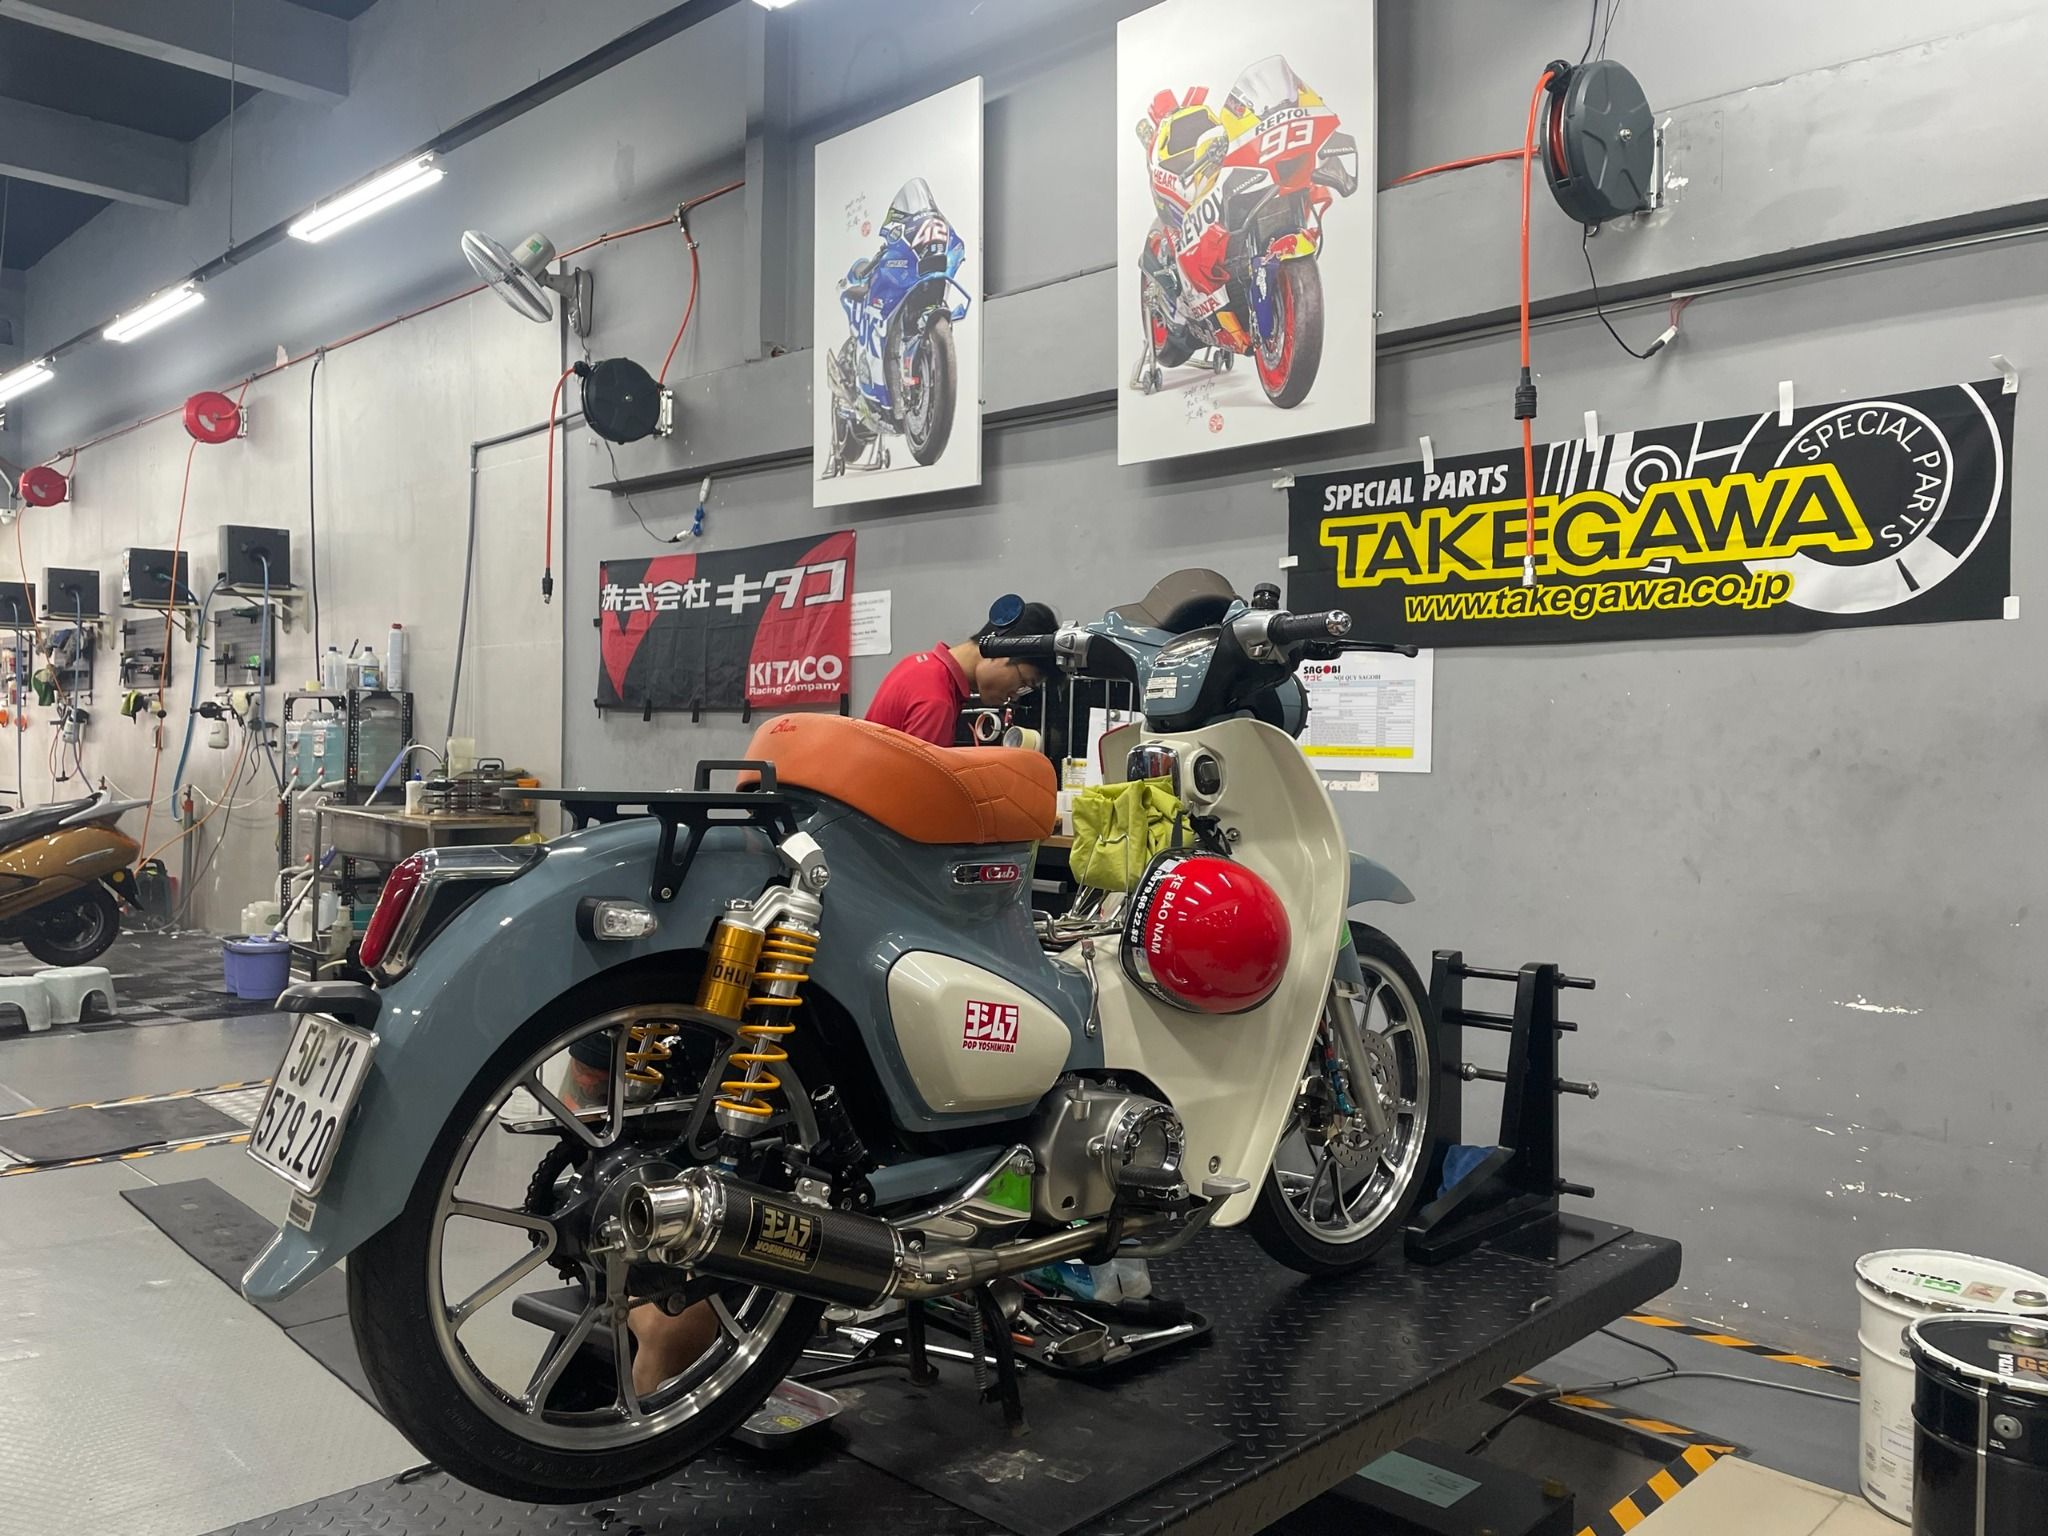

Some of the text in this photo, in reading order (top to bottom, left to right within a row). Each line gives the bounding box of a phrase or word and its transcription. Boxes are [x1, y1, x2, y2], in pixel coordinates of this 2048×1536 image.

[1259, 119, 1314, 165] 93
[1153, 168, 1178, 191] HEART
[1323, 464, 1509, 512] SPECIAL PARTS
[1798, 410, 1942, 548] SPECIAL PARTS
[1320, 464, 1873, 588] TAKEGAWA
[601, 559, 847, 614] 株式会社 キタコ
[1405, 571, 1793, 622] www.takegawa.co.jp
[749, 655, 843, 687] KITACO
[749, 682, 841, 696] Racing Company
[1303, 665, 1341, 674] SAGOBI
[1151, 923, 1165, 954] NAM
[966, 1002, 1017, 1040] ヨシムラ
[290, 1023, 358, 1103] 50-Y1
[963, 1040, 1014, 1053] POP YOSHIMURA
[257, 1087, 337, 1180] 579.20
[763, 1208, 811, 1247] ヨシムラ
